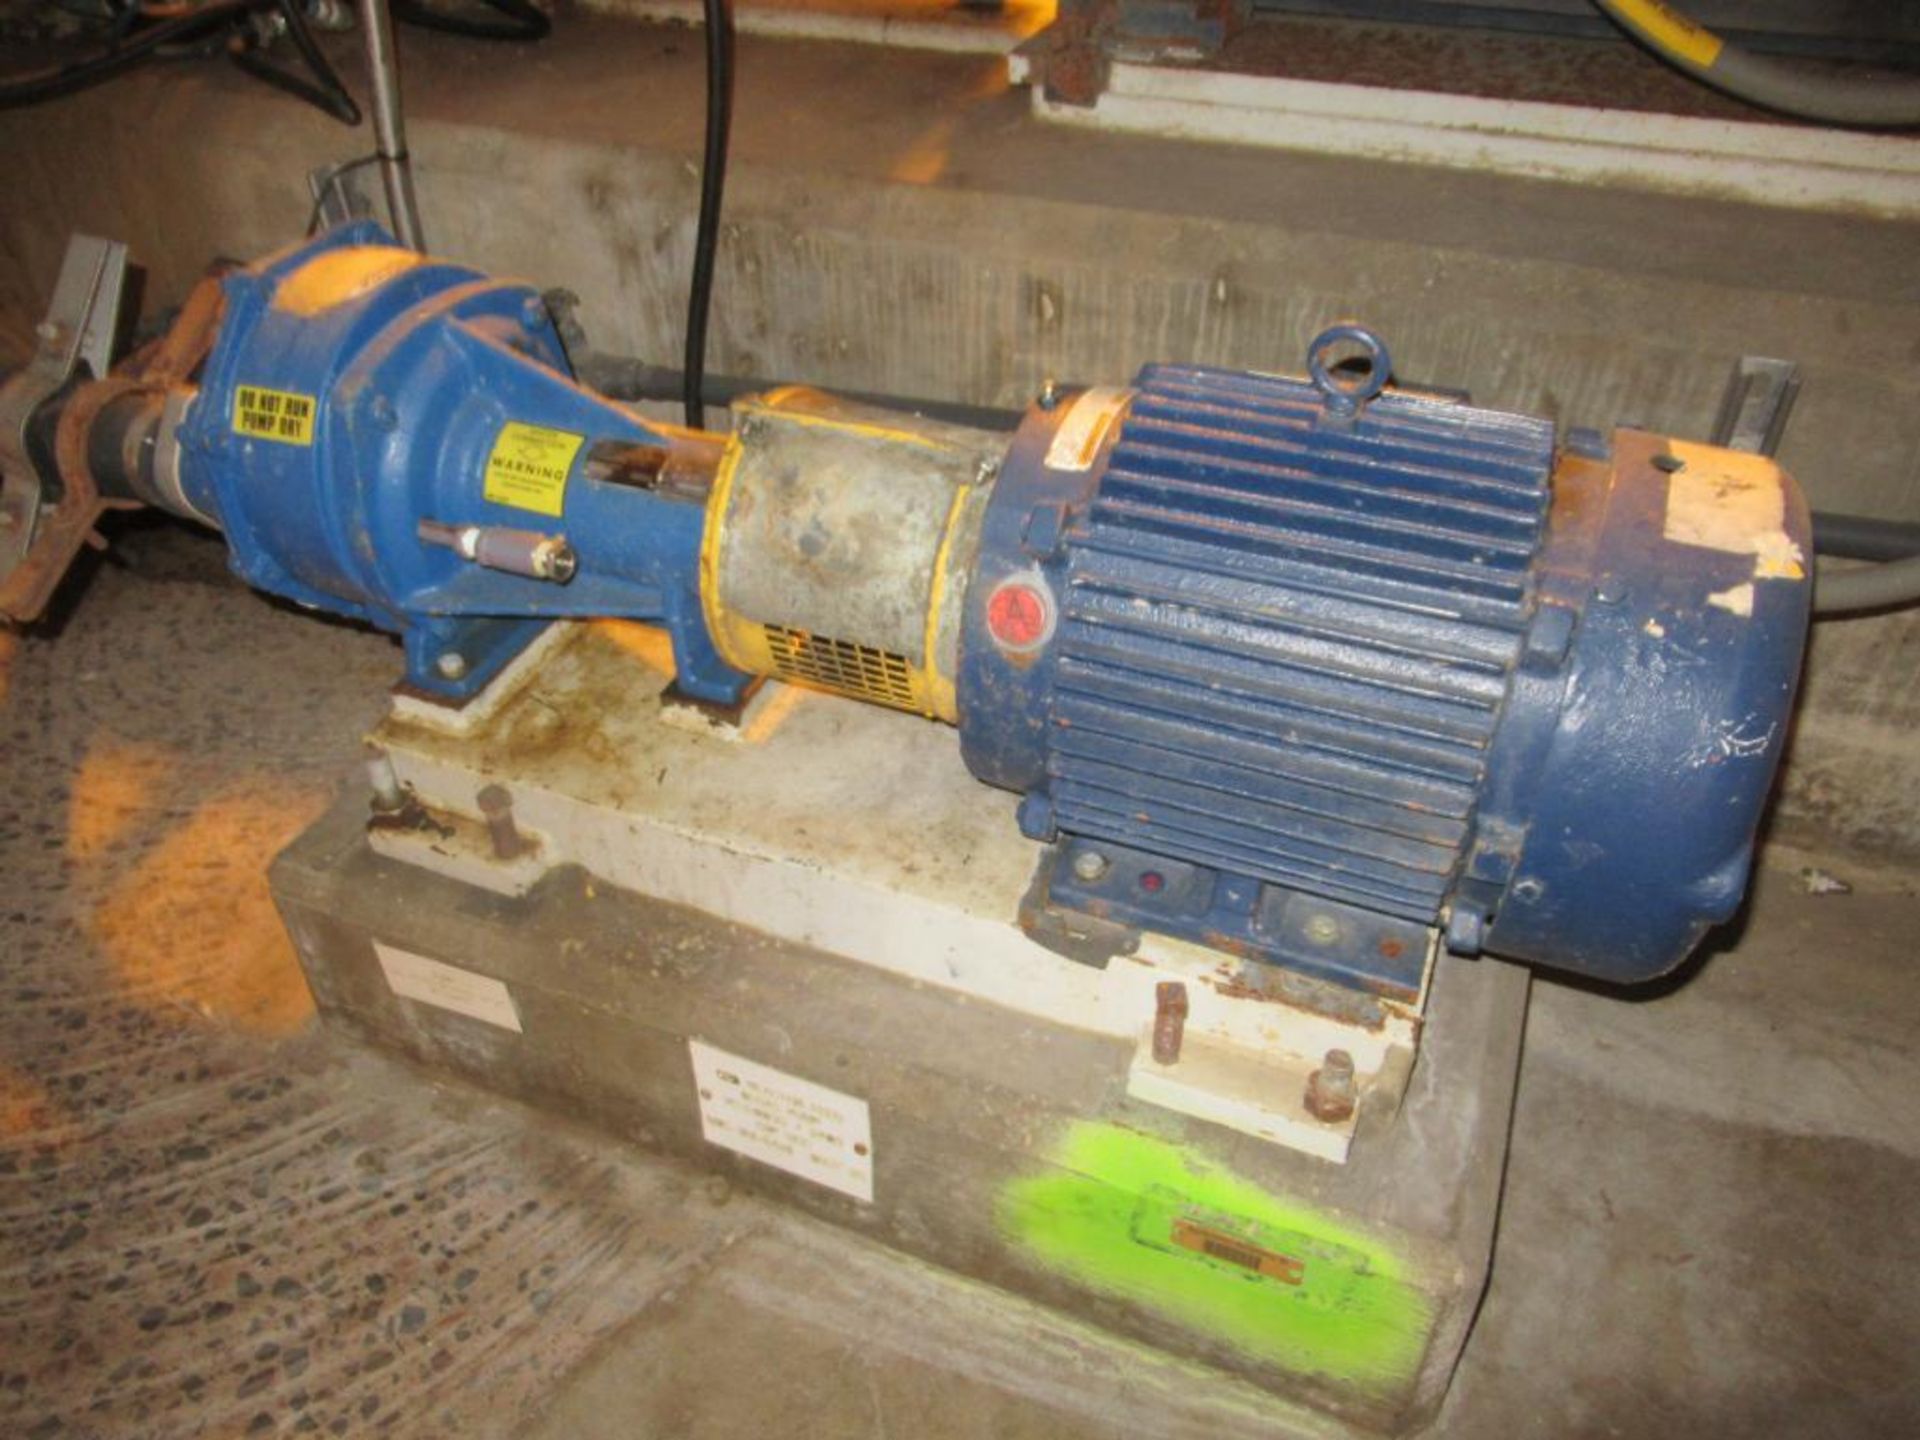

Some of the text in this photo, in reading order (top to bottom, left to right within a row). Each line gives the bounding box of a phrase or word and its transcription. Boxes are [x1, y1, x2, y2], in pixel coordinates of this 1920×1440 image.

[239, 388, 309, 417] DO NOT RUN
[242, 409, 302, 437] PUMP DRY
[492, 457, 564, 482] WARNING
